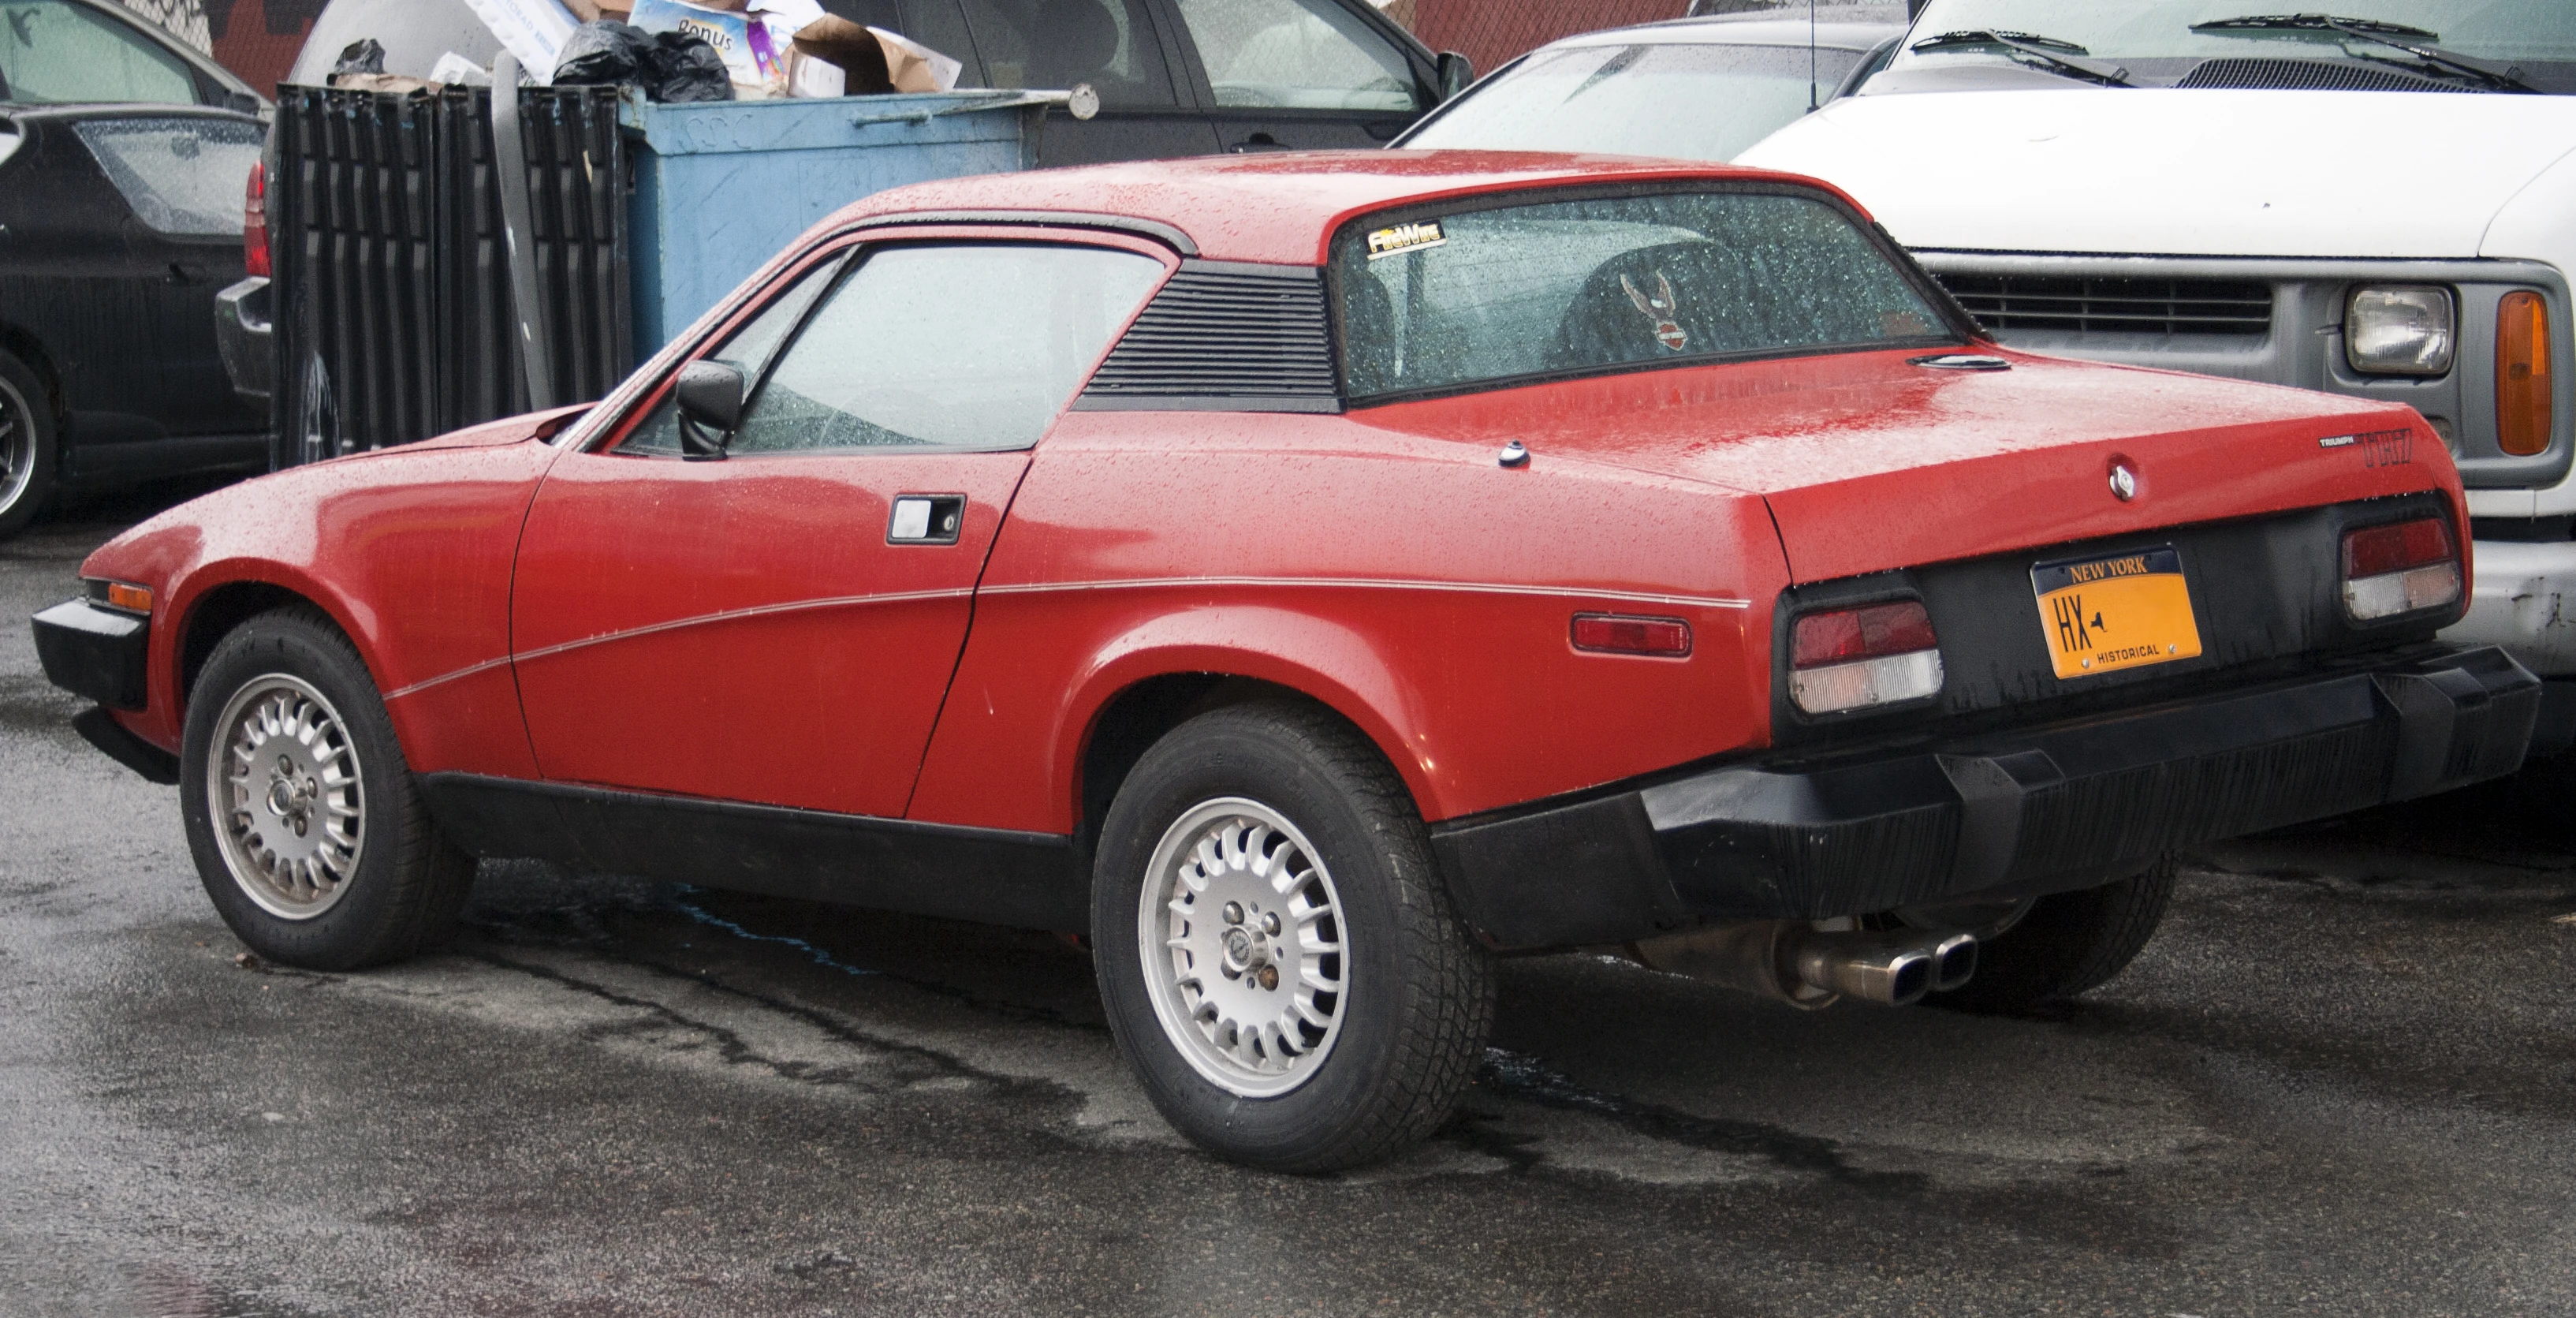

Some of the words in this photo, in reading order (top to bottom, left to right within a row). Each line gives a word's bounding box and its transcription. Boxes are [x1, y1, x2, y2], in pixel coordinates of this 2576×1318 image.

[2320, 435, 2354, 447] TRIUMPH
[2070, 563, 2104, 584] NEW
[2108, 556, 2148, 575] YORK
[2097, 644, 2160, 664] HISTORICAL
